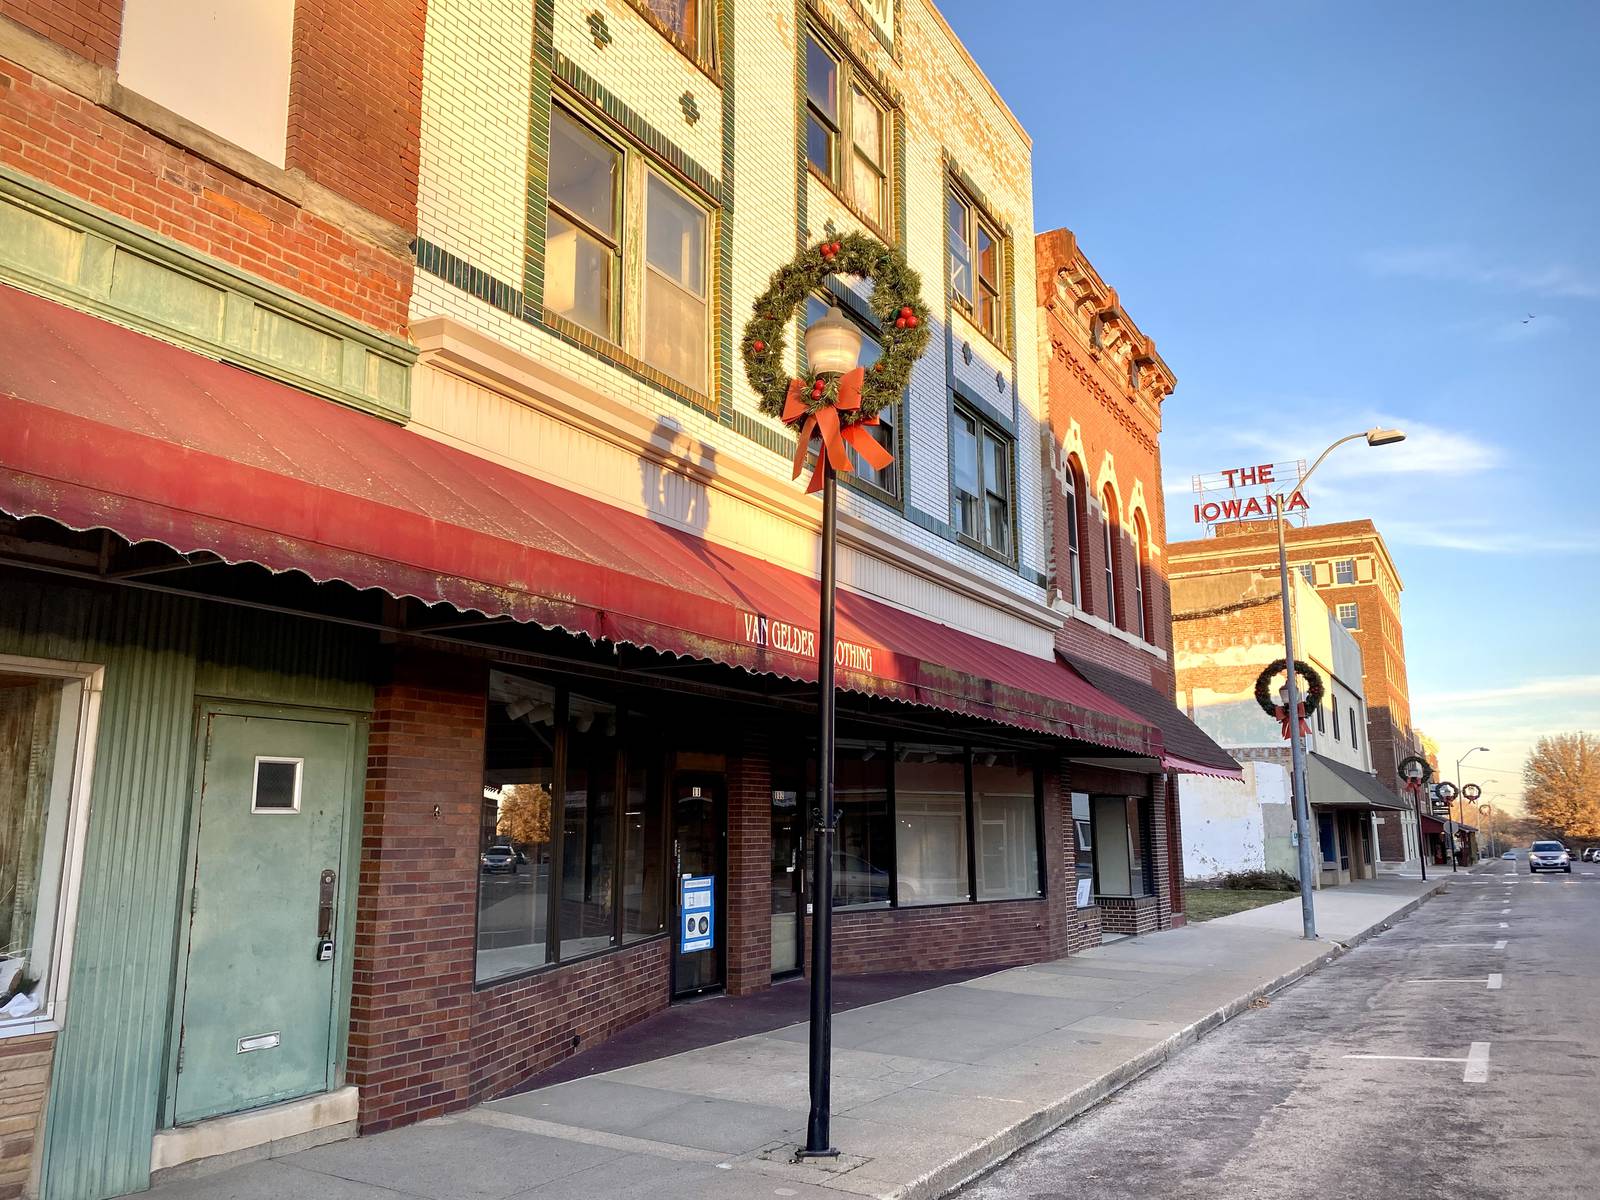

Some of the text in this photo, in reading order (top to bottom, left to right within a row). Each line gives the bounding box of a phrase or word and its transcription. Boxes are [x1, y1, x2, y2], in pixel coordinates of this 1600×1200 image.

[1221, 463, 1275, 488] THE
[1193, 491, 1310, 523] IOWANA
[744, 613, 873, 672] VAN GELDER OTHING
